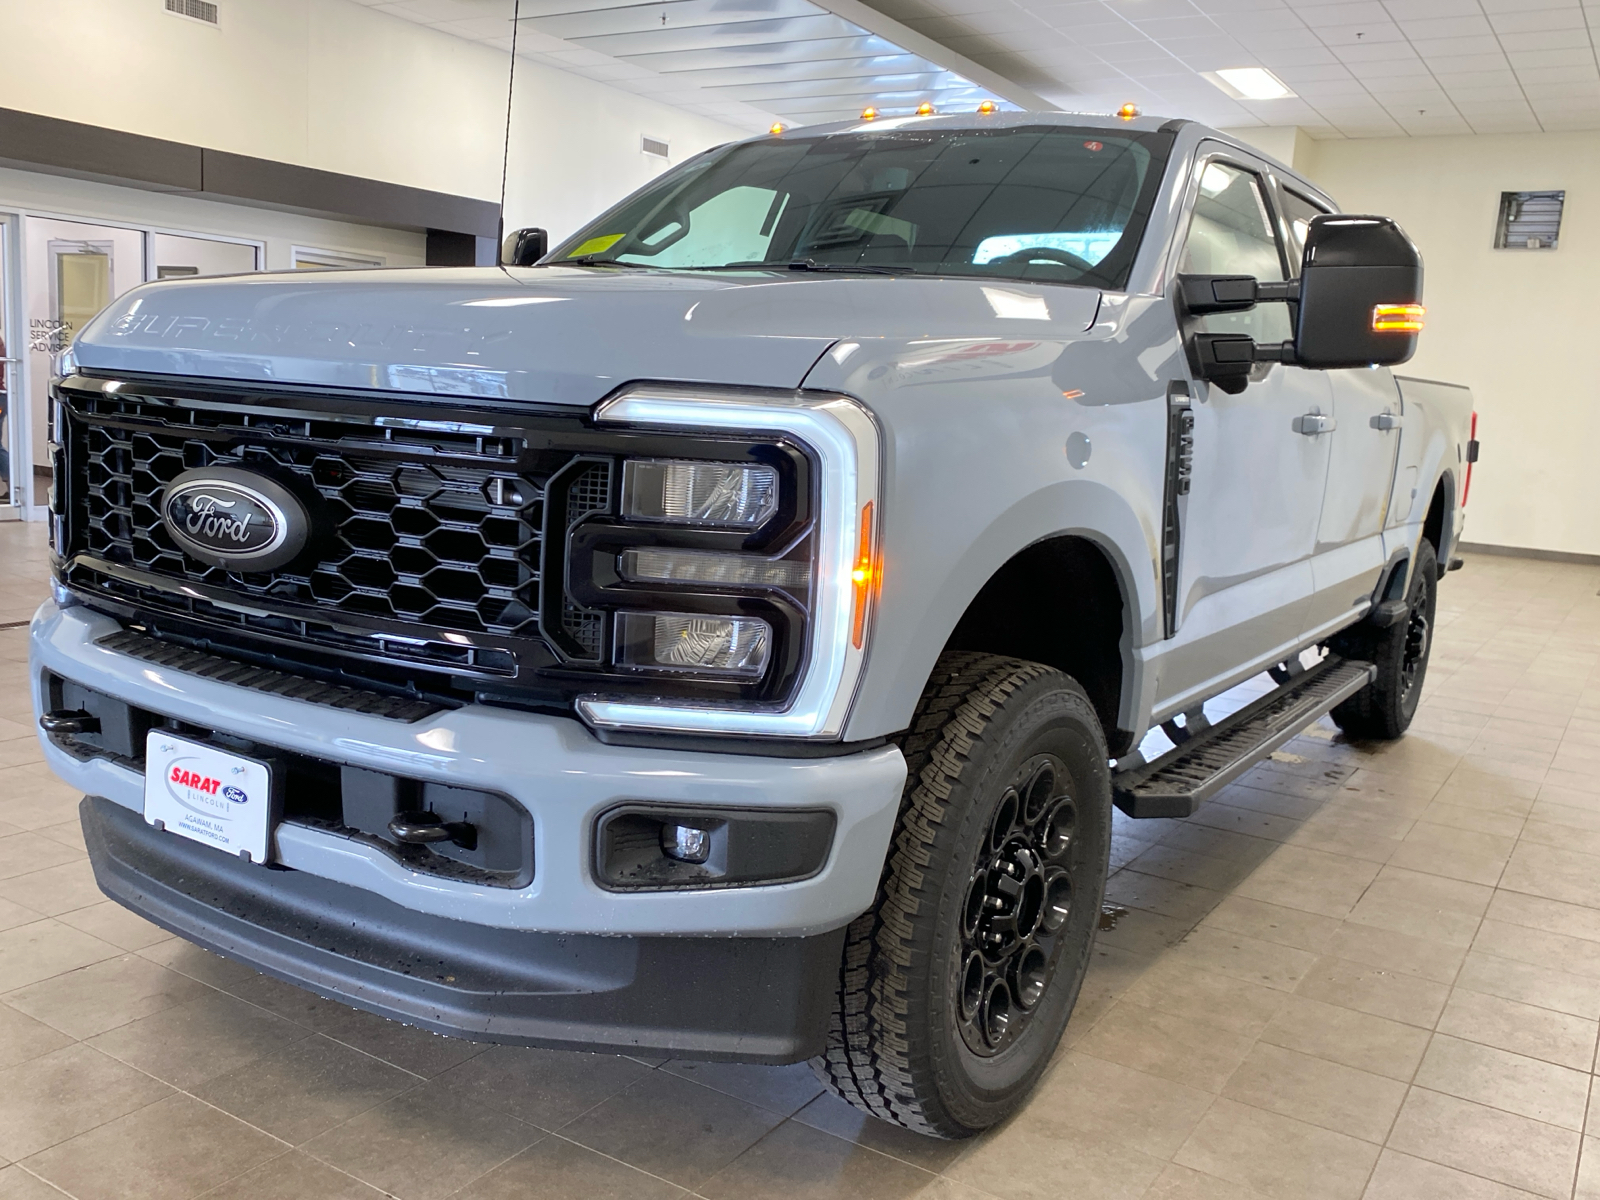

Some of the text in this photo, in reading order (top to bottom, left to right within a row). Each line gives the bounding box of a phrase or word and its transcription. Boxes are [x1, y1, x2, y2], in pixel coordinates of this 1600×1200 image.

[29, 318, 73, 330] LINCOLN
[30, 330, 70, 342] SERVICE
[186, 494, 252, 543] Ford
[170, 766, 222, 796] SARAT
[192, 794, 225, 809] LINCOLN
[225, 786, 245, 803] Ford
[184, 813, 224, 834] AGAWAM, MA
